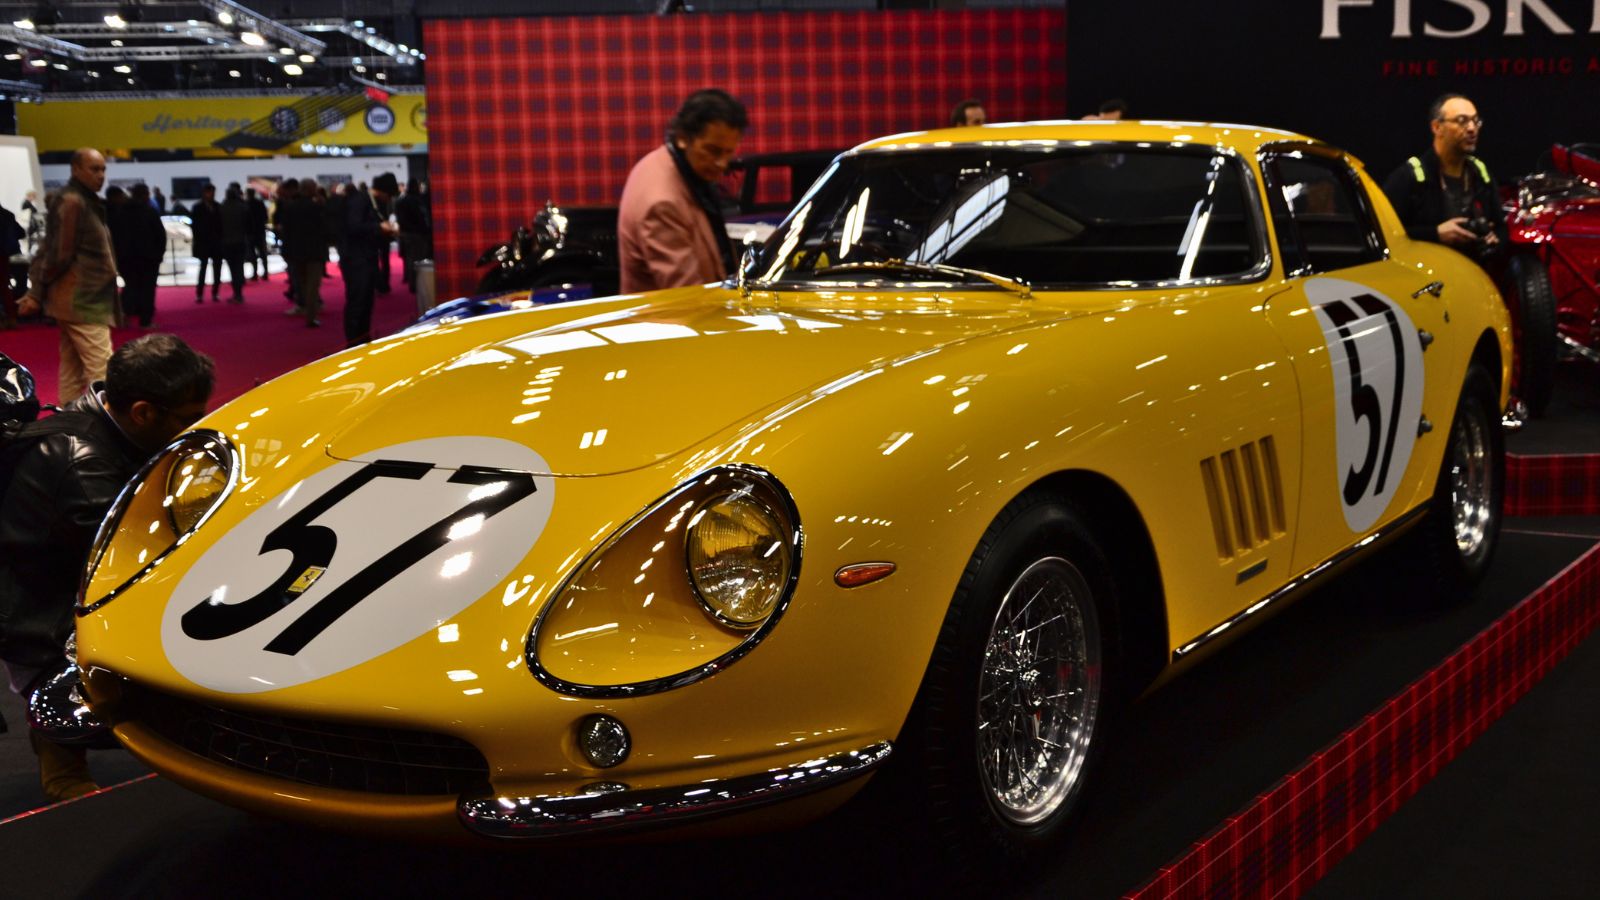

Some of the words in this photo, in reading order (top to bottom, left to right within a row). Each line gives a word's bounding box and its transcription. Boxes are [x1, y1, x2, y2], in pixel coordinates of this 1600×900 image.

[1382, 60, 1438, 77] FINE
[1455, 57, 1573, 76] HISTORIC
[1323, 293, 1405, 506] 57
[181, 459, 537, 656] 57
